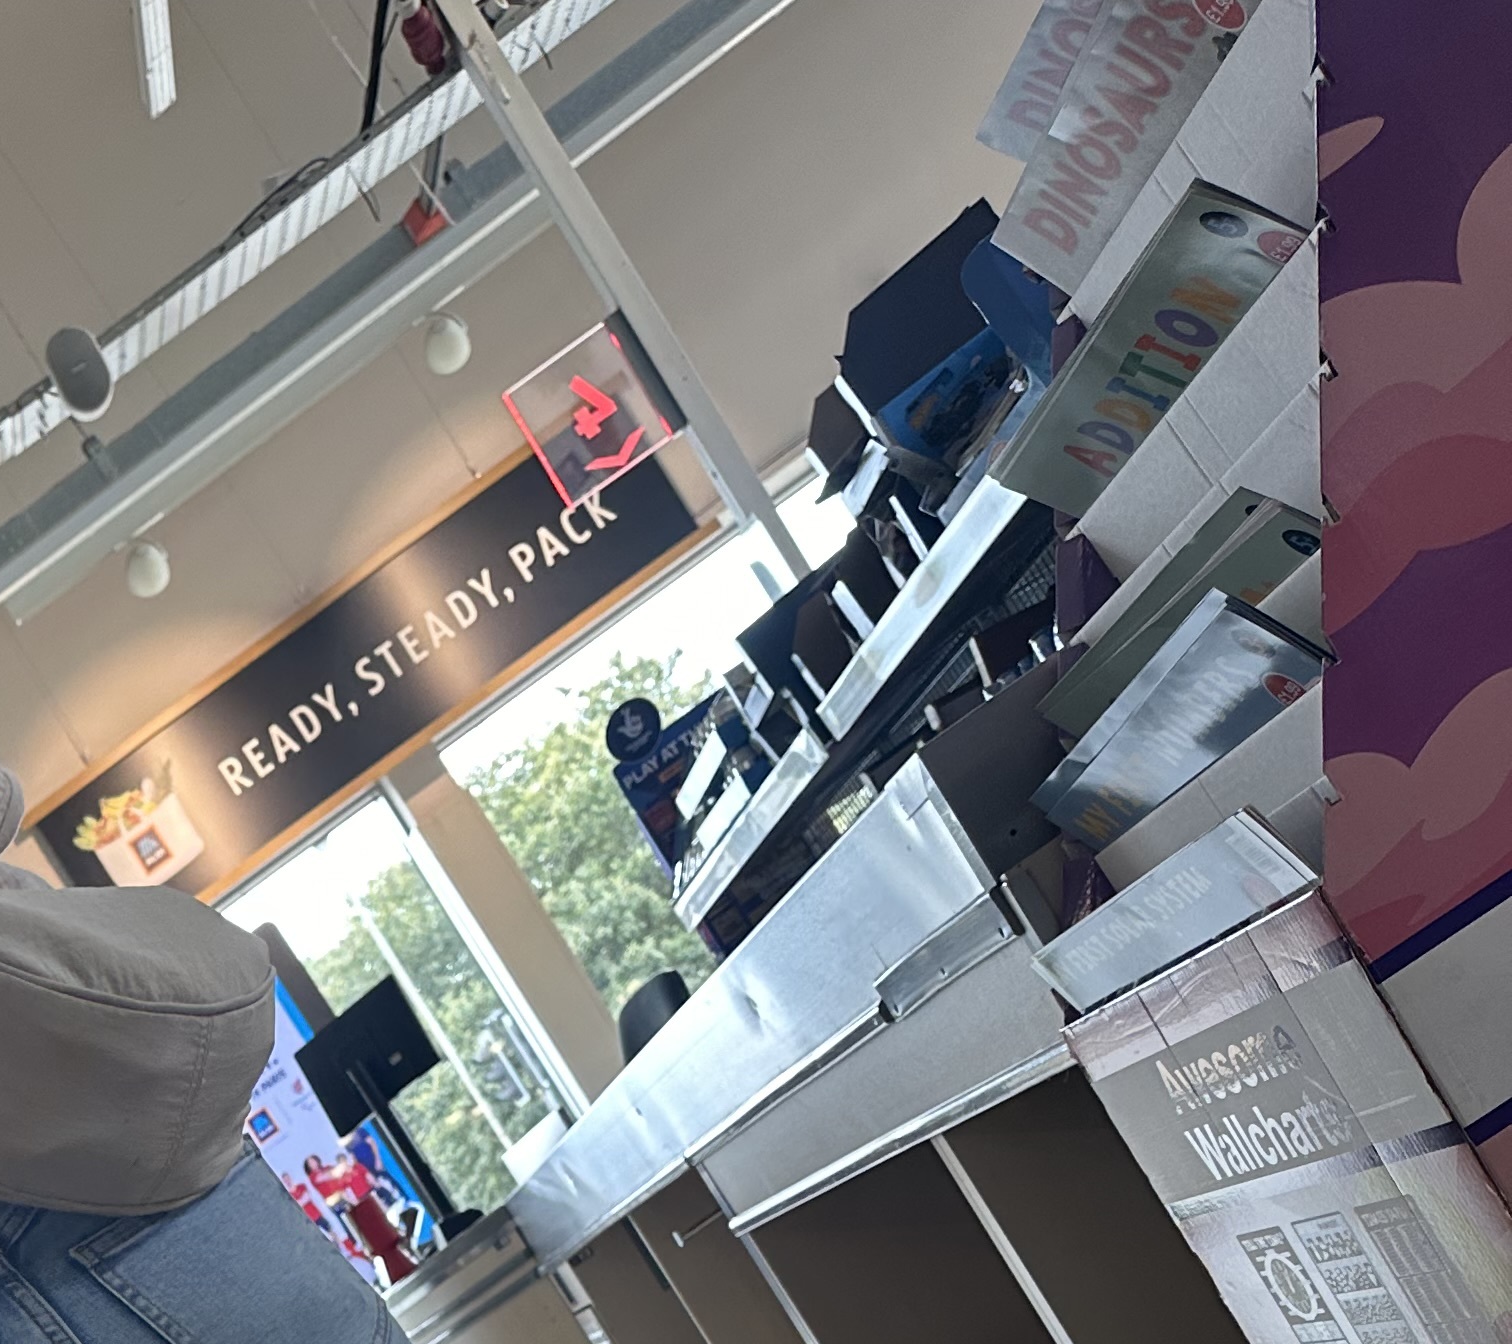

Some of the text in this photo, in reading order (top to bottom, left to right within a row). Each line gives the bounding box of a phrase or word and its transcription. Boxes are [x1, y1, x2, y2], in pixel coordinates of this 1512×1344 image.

[1021, 0, 1202, 257] DINOSAURS
[1063, 276, 1245, 477] ADDITION
[217, 490, 617, 796] READY, STEADY, PACK
